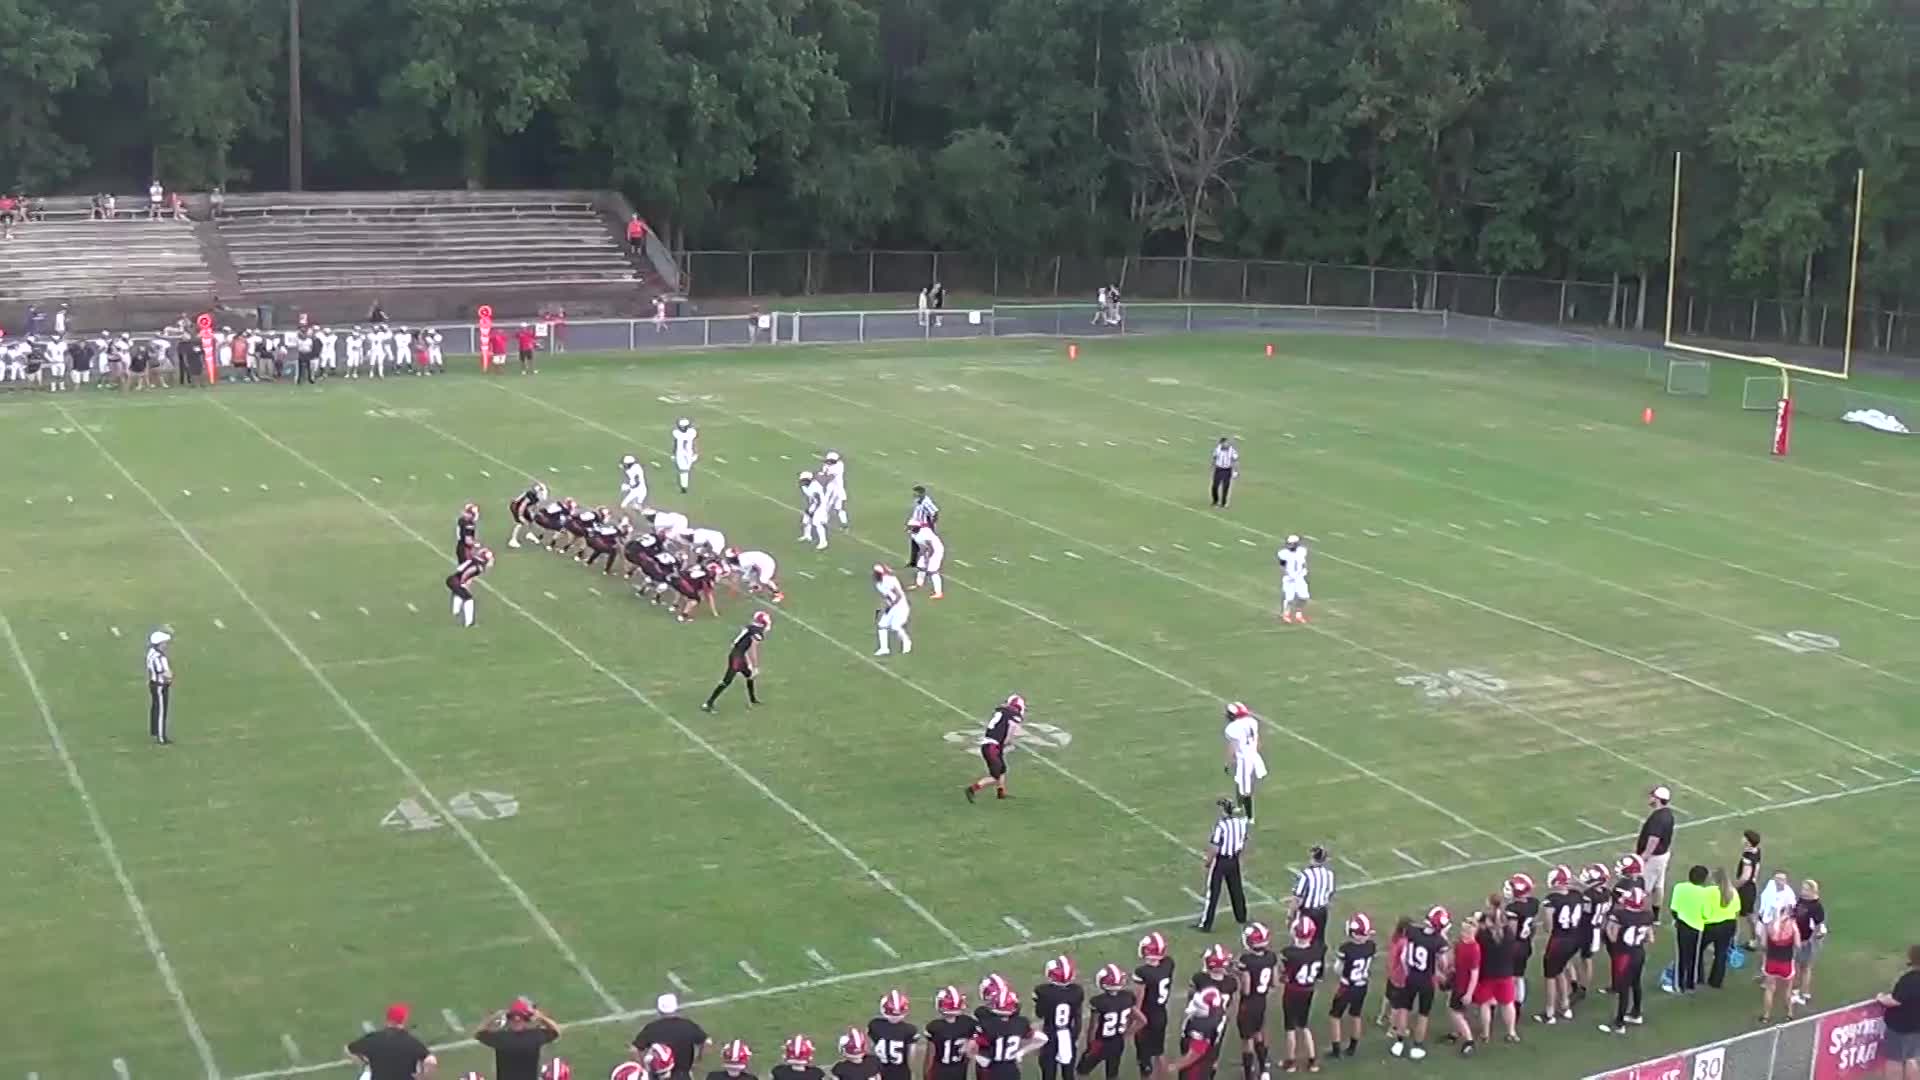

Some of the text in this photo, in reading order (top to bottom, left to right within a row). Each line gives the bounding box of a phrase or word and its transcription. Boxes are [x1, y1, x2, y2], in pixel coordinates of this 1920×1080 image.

[380, 791, 519, 830] 40
[1408, 943, 1428, 971] 19
[1158, 977, 1170, 1004] 5
[1257, 967, 1272, 993] 9
[1055, 1004, 1070, 1026] 8
[875, 1039, 904, 1065] 45
[942, 1039, 965, 1064] 13
[994, 1036, 1020, 1062] 12
[1697, 1058, 1721, 1080] 30
